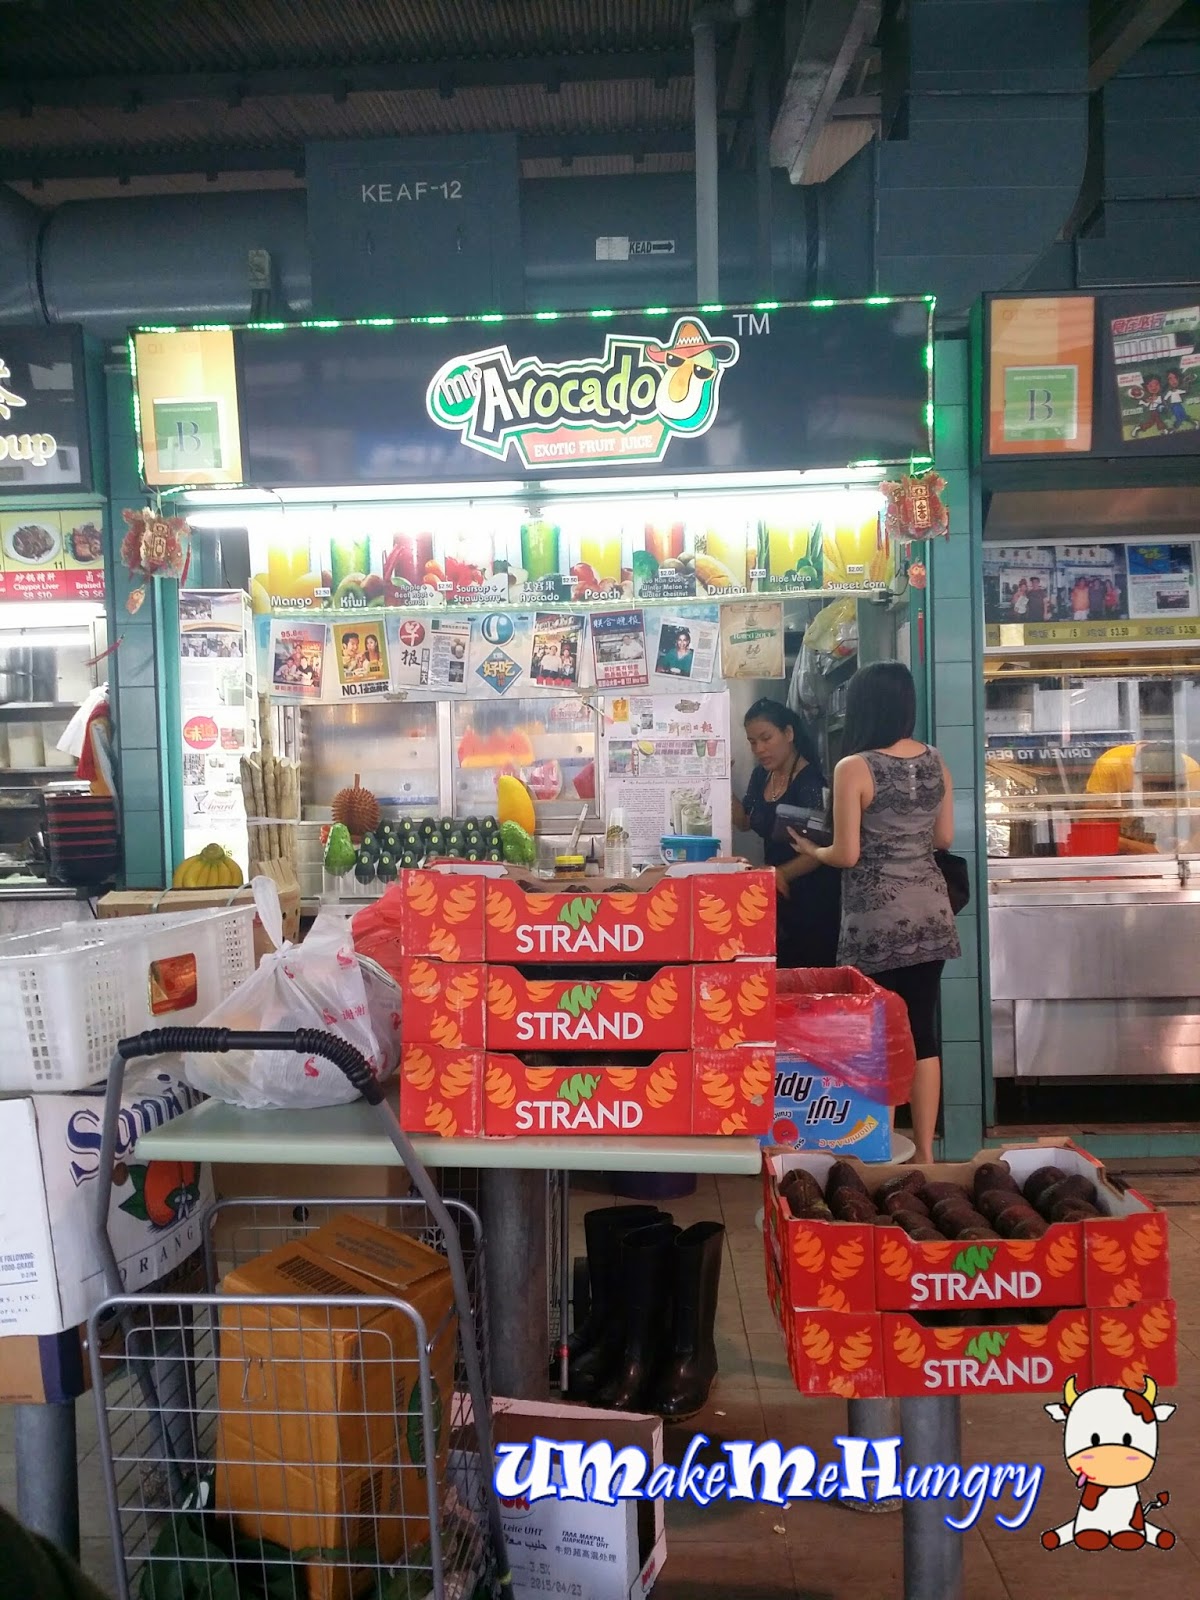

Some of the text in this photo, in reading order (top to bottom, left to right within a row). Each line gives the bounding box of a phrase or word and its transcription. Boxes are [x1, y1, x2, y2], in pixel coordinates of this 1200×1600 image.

[361, 180, 462, 203] KEAF-12
[629, 241, 652, 254] KEAD
[733, 313, 770, 336] TM
[479, 354, 656, 433] Avocado
[1026, 388, 1053, 422] B
[176, 421, 201, 452] B
[533, 436, 653, 458] EXOTIC FRUIT JUICE
[769, 574, 812, 583] Aloe Vera
[827, 580, 886, 590] Sweet Corn
[13, 582, 59, 592] Claypot Liver
[400, 584, 421, 592] Apple
[456, 584, 490, 594] Soursop
[584, 588, 621, 600] Peach
[707, 584, 748, 596] Durian
[271, 595, 313, 608] Mango
[340, 592, 367, 608] Kiwi
[453, 594, 501, 604] Strawberry
[520, 592, 560, 603] Avocado
[515, 924, 644, 954] STRAND
[515, 1012, 644, 1041] STRAND
[515, 1101, 643, 1129] STRAND
[774, 1111, 792, 1119] Crunc
[805, 1096, 851, 1125] Fuji
[844, 1121, 875, 1144] Vitamin
[910, 1271, 1042, 1302] STRAND
[924, 1357, 1054, 1388] STRAND
[524, 1527, 543, 1536] UHT
[596, 1541, 610, 1549] UHT
[530, 1577, 583, 1596] 2015/04/23
